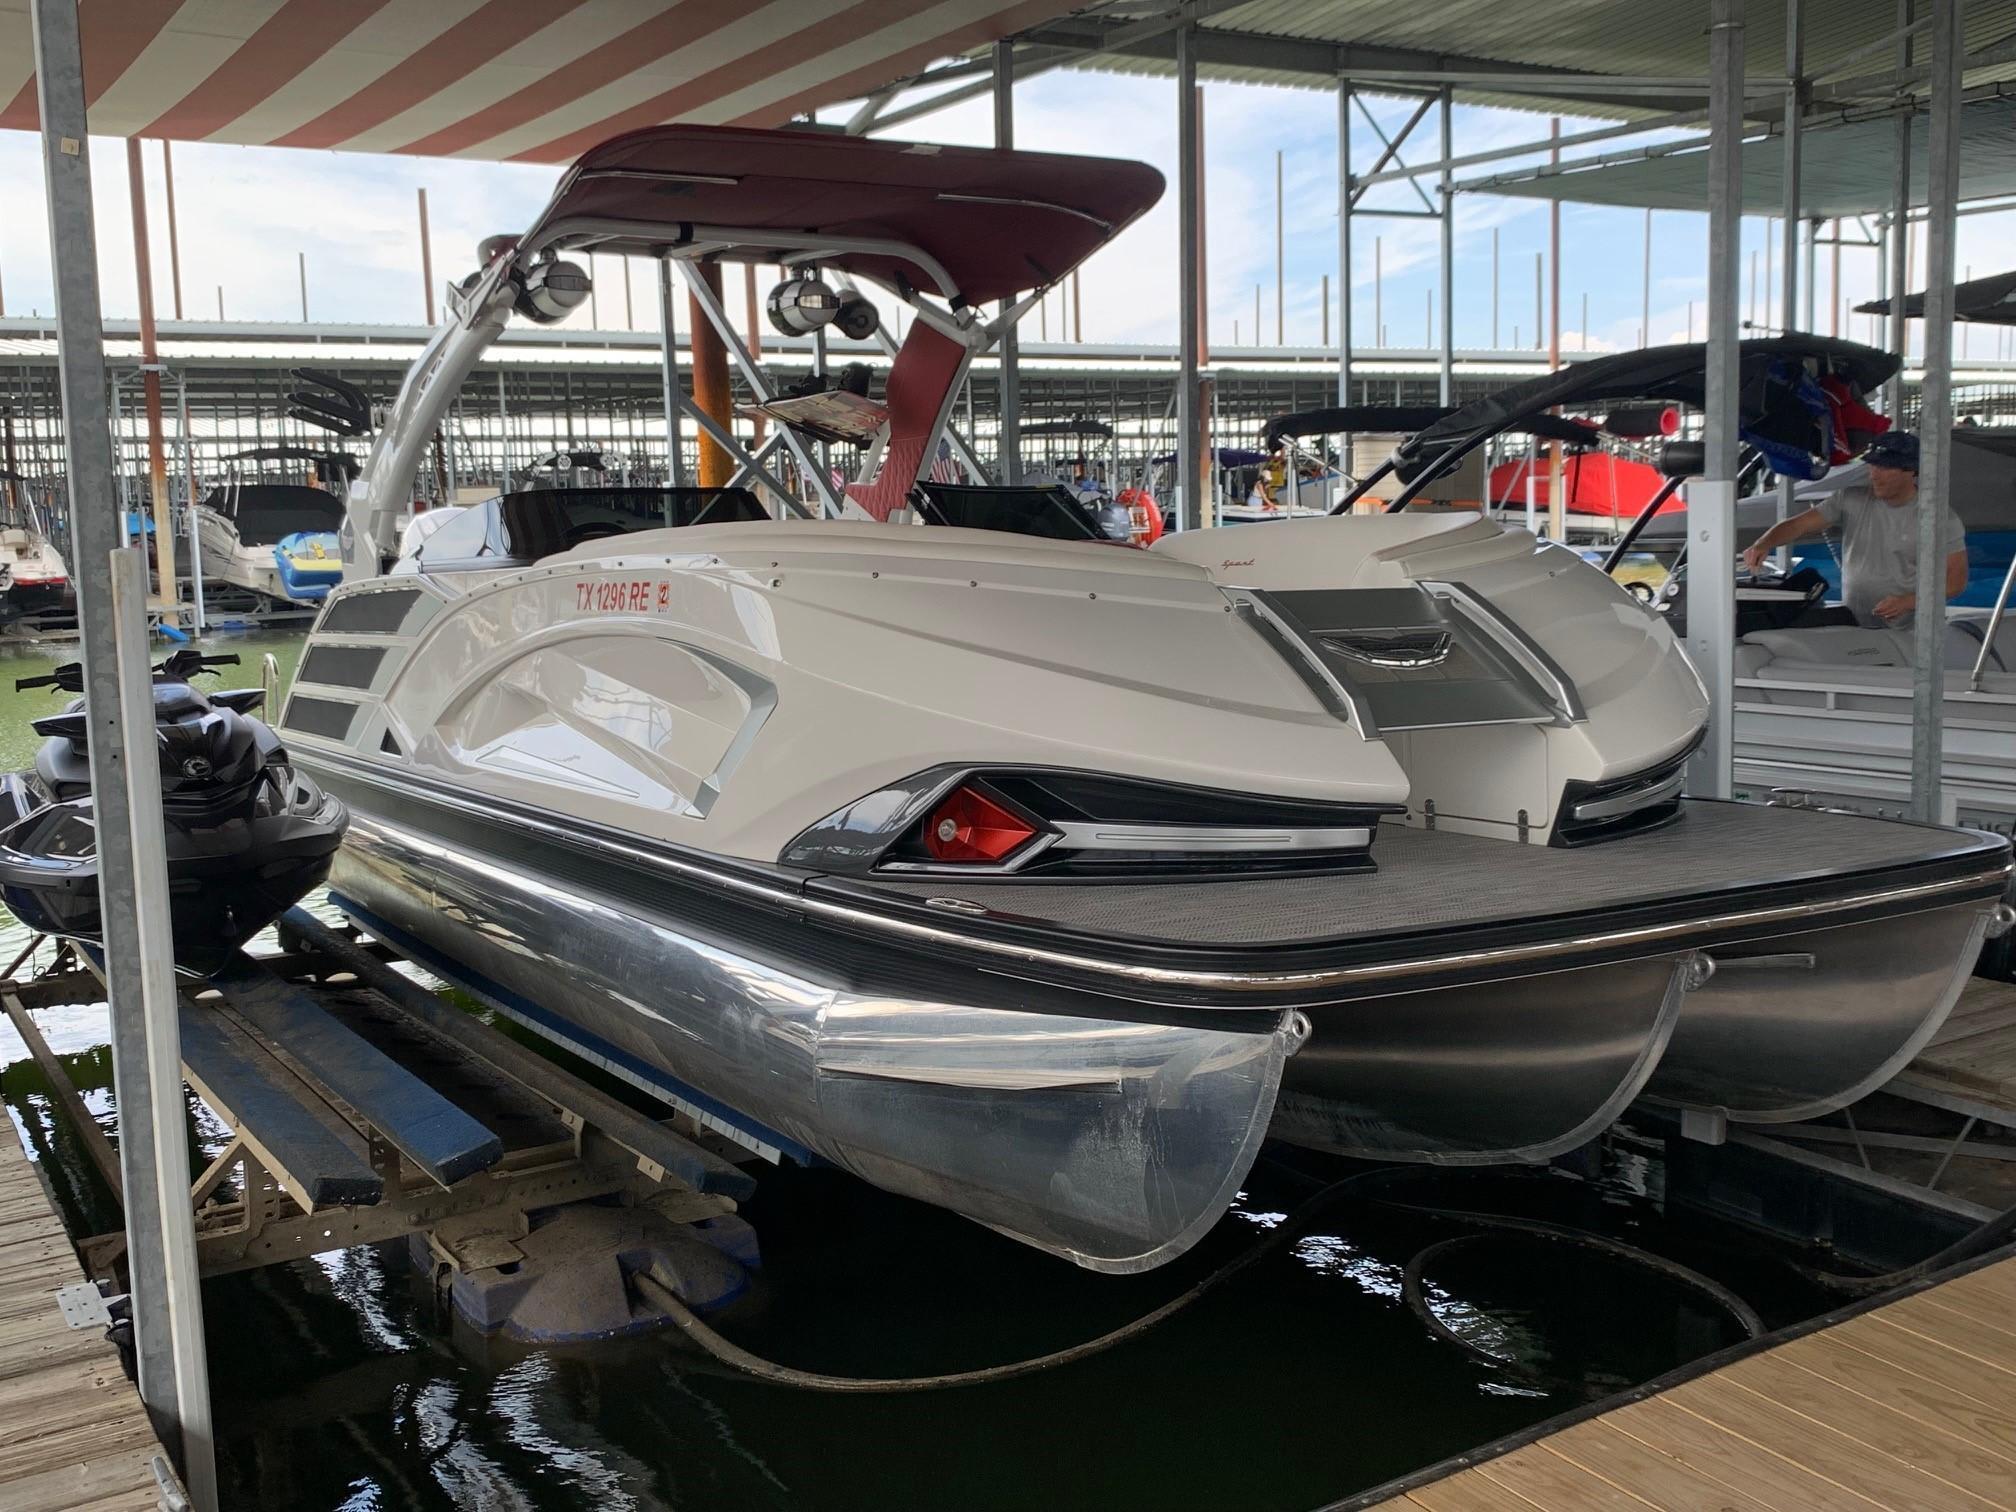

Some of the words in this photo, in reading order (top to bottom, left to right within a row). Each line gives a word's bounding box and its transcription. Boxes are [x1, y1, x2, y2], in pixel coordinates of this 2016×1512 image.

[576, 583, 594, 611] TX
[596, 582, 627, 611] 1296
[628, 581, 651, 611] RE
